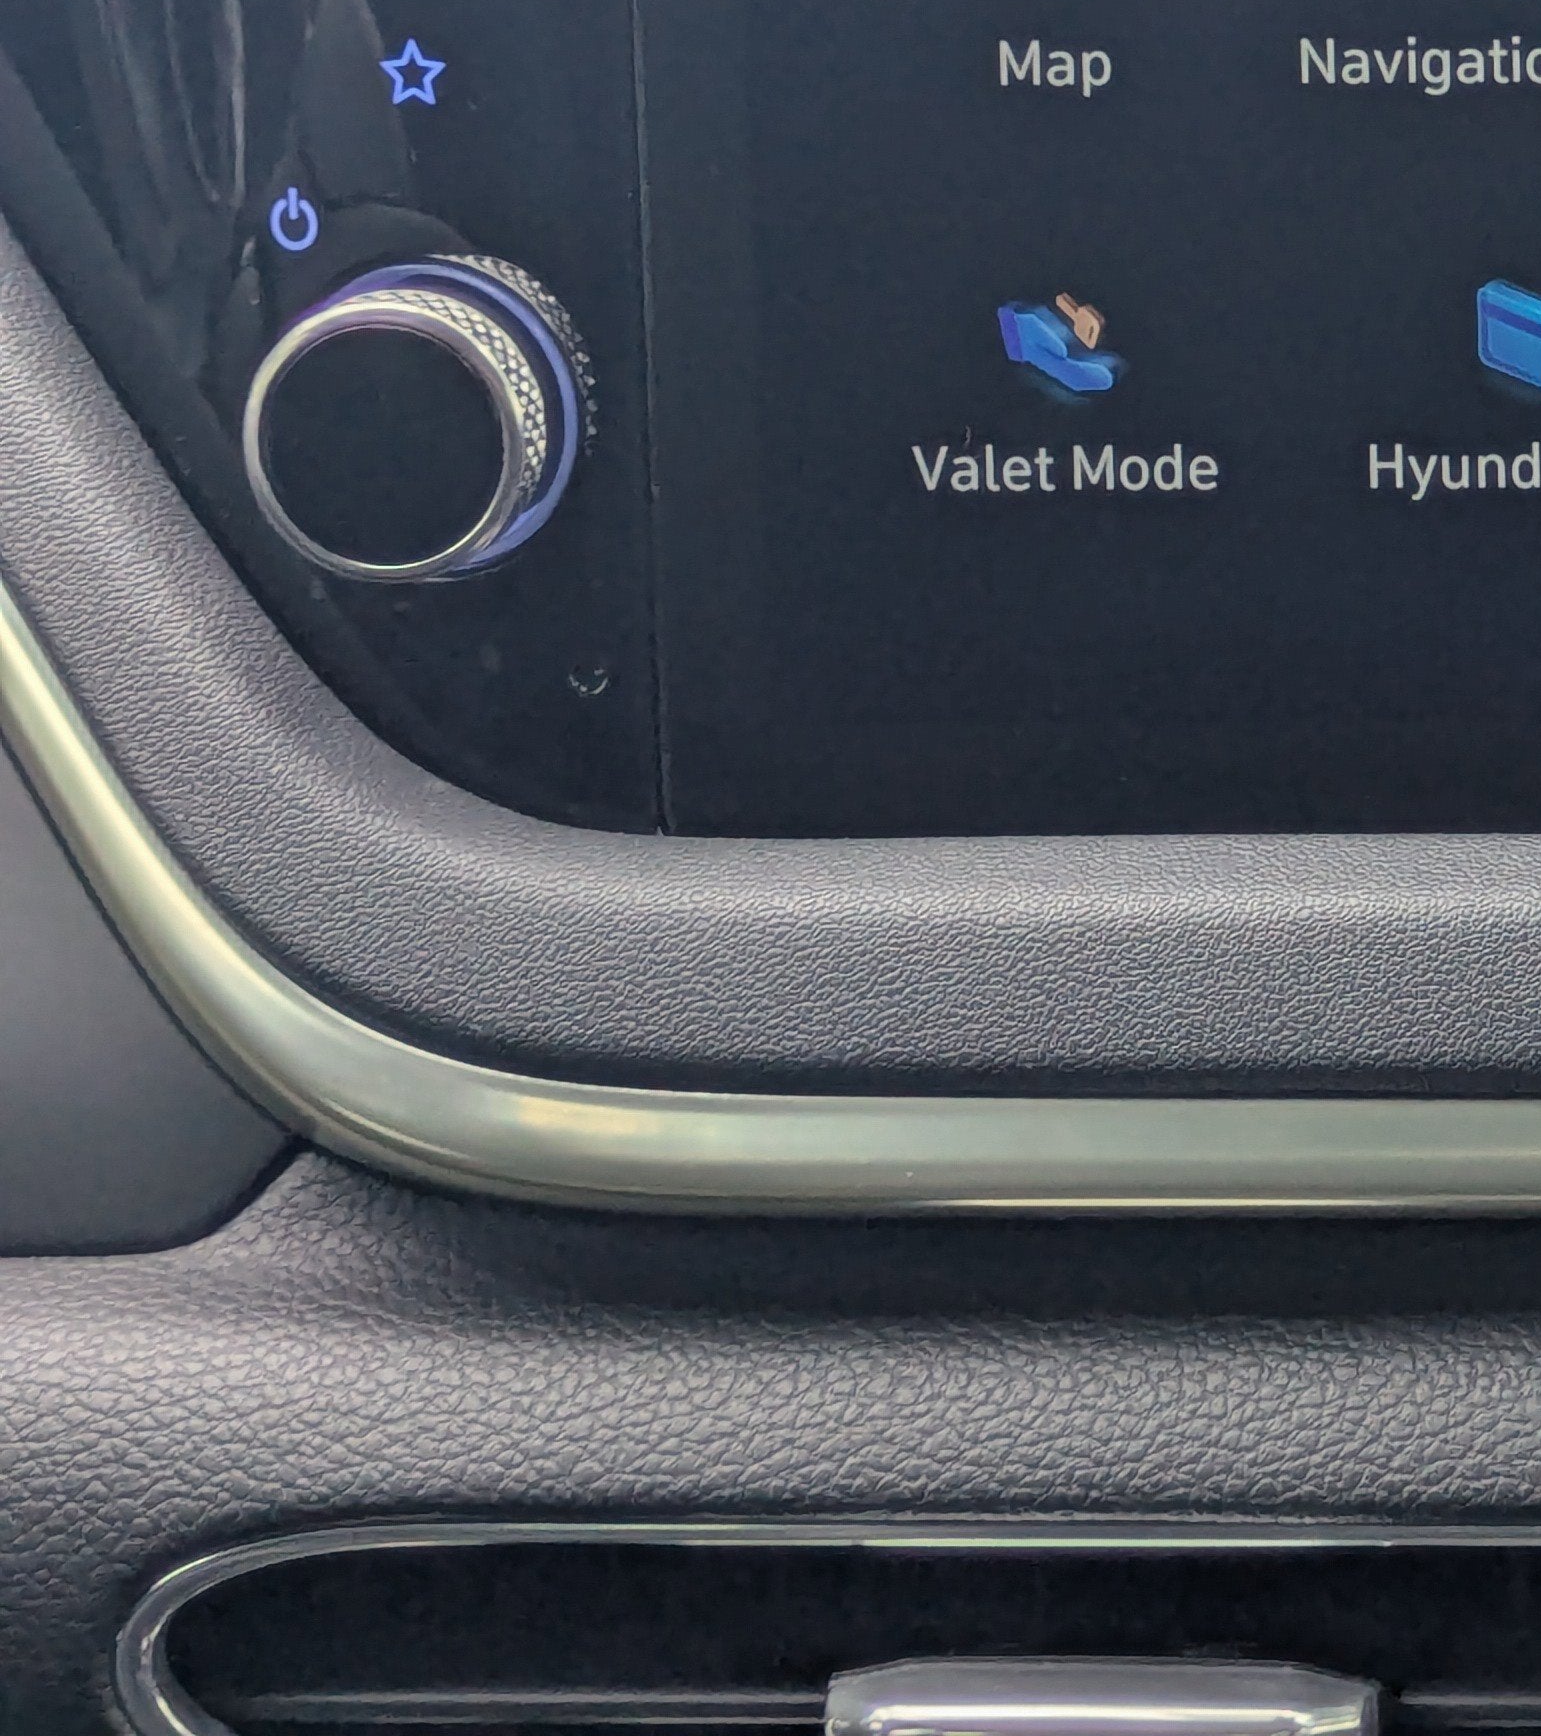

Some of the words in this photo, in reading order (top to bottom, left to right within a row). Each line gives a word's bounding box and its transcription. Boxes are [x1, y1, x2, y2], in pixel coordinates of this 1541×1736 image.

[999, 39, 1112, 98] Map
[911, 443, 1056, 492] Valet
[1072, 443, 1219, 492] Mode
